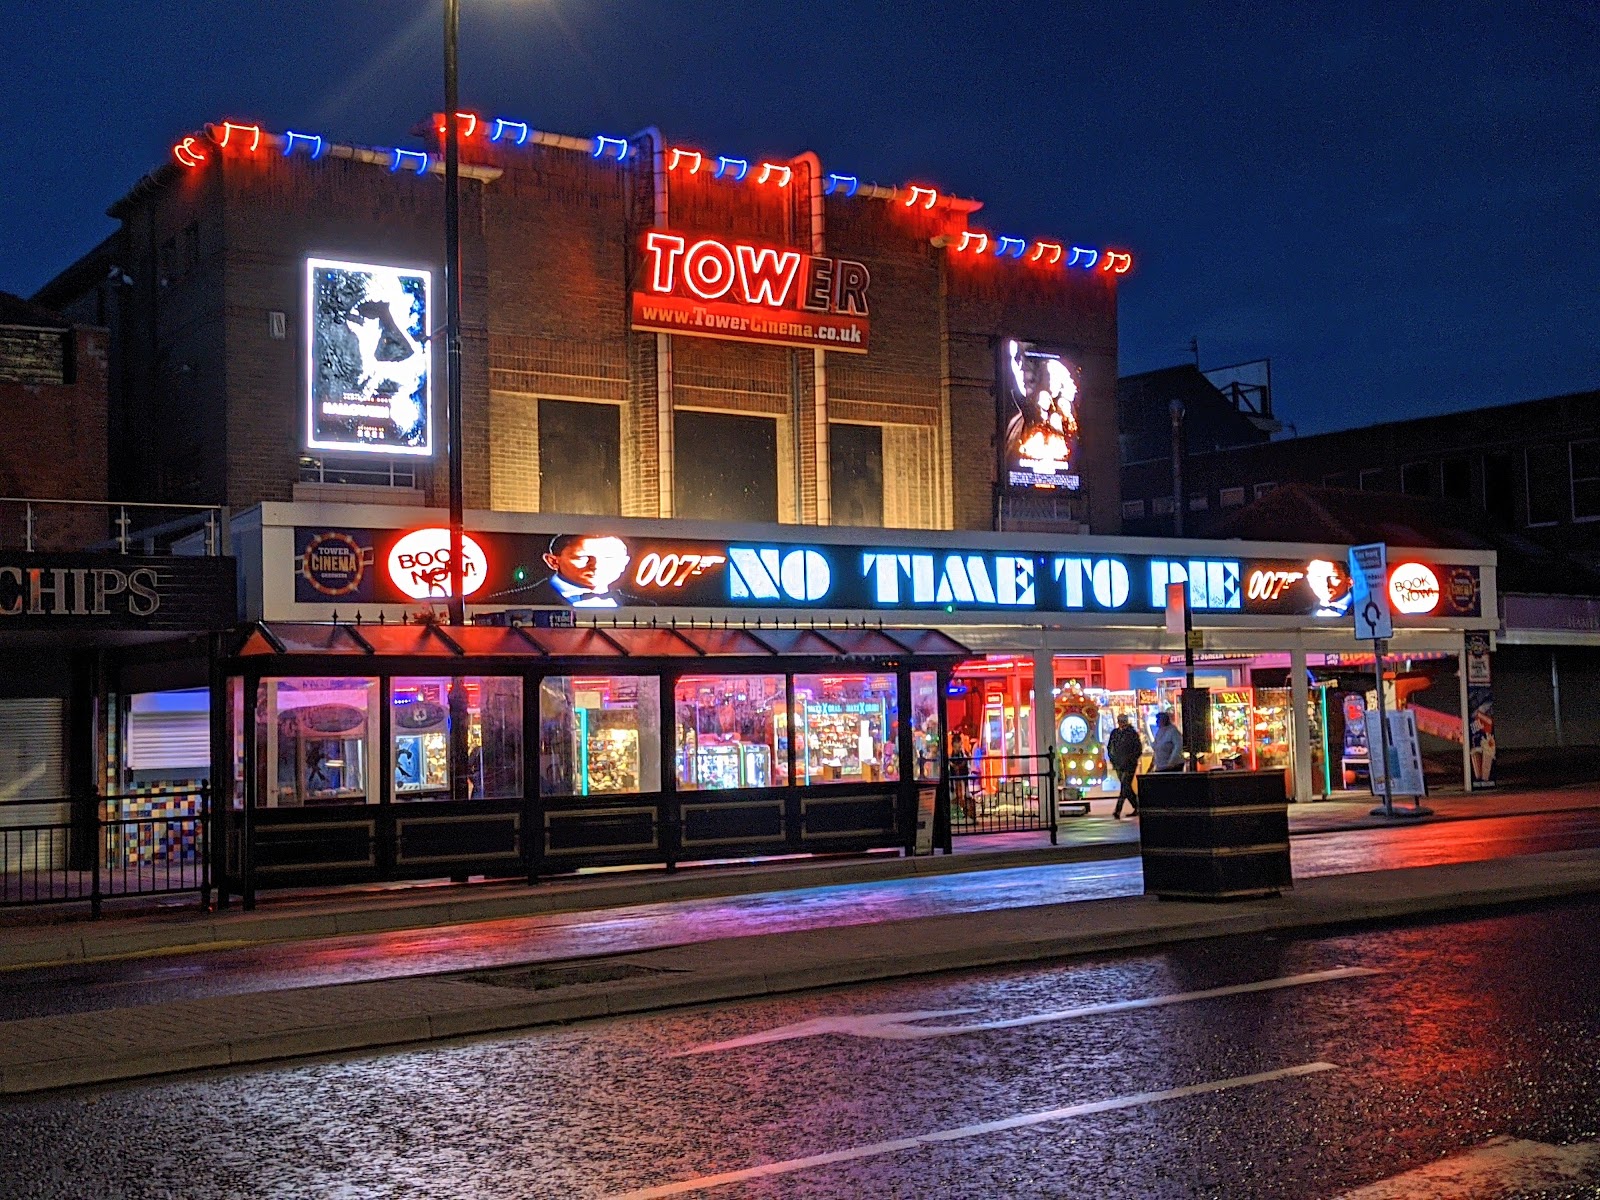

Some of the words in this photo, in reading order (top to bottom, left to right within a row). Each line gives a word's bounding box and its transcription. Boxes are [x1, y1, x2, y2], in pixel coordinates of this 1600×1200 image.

[647, 233, 871, 316] TOWER
[641, 305, 862, 343] www.TowerCinema.co.uk
[311, 553, 357, 571] CINEMA
[318, 547, 349, 555] TOWER
[635, 553, 704, 587] 007
[729, 547, 831, 601] NO
[863, 553, 1036, 605] TIME
[1055, 558, 1130, 608] TO
[1248, 570, 1292, 601] 007
[1395, 575, 1431, 592] BOOK
